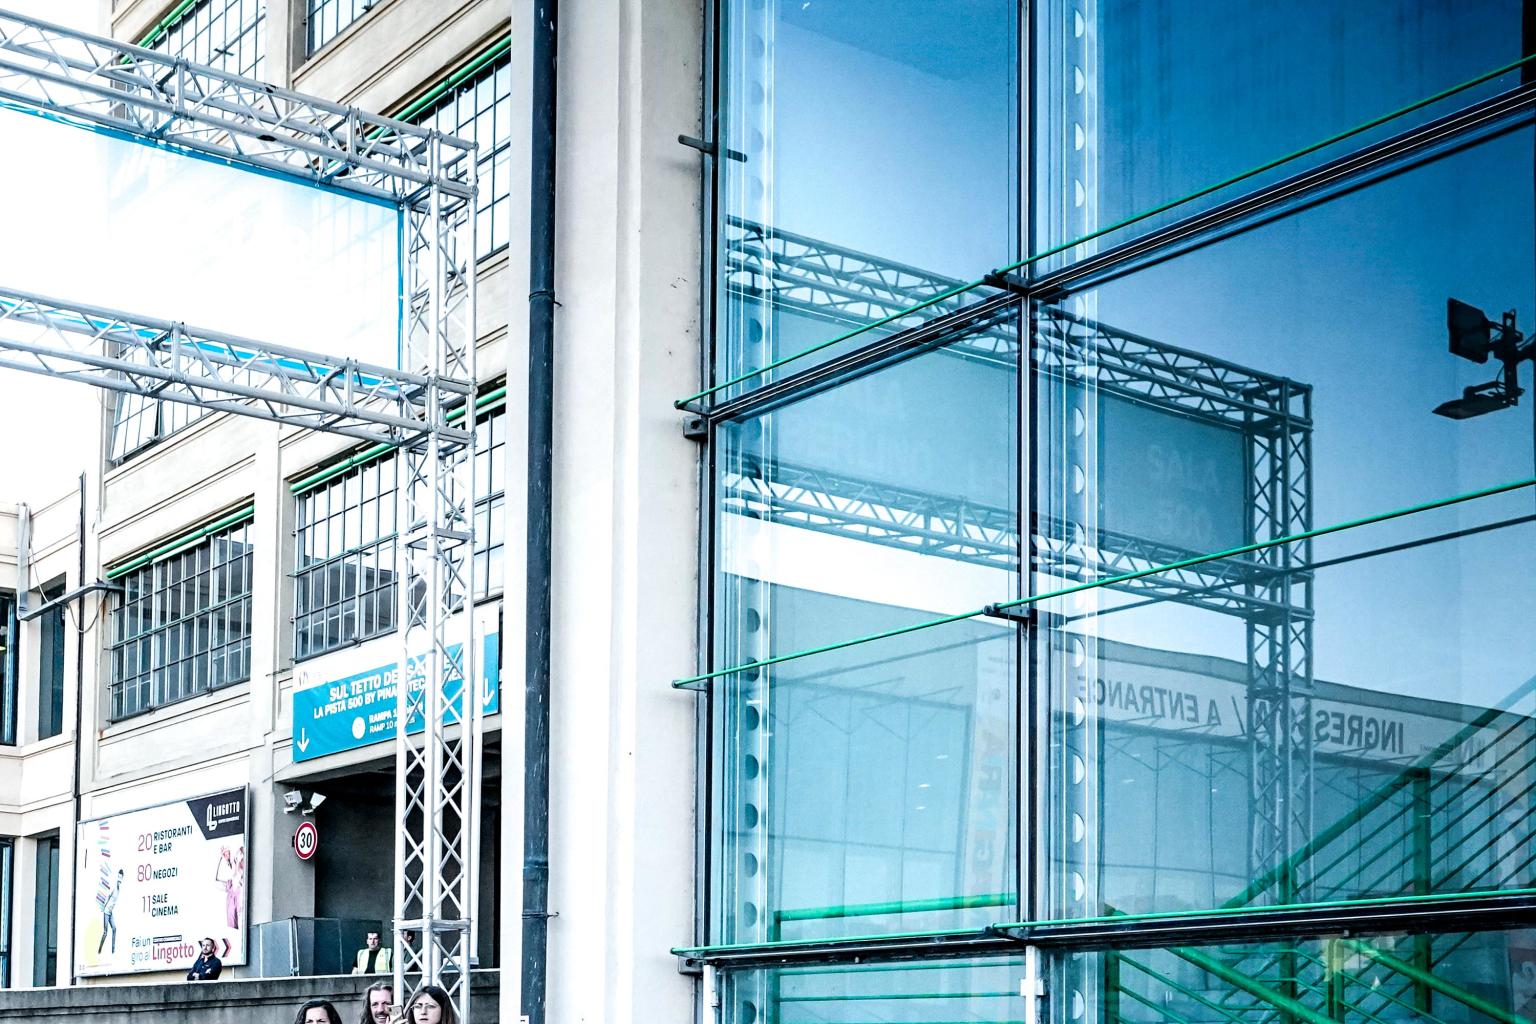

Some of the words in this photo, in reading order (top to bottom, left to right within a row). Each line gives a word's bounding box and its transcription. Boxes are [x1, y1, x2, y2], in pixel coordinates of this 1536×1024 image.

[329, 686, 349, 702] SUL
[350, 674, 381, 695] TETTO
[383, 669, 398, 687] DE
[314, 707, 324, 719] LA
[325, 700, 347, 717] PISTA
[347, 696, 364, 711] 500
[364, 692, 376, 706] BY
[213, 801, 240, 817] LINGOTTO
[138, 832, 153, 852] 20
[153, 825, 193, 841] RISTORANTI
[153, 844, 158, 854] E
[159, 842, 173, 852] BAR
[300, 832, 313, 848] 30
[137, 863, 152, 882] 80
[153, 867, 178, 880] NEGOZI
[142, 895, 151, 913] 11
[152, 893, 168, 905] SALE
[151, 905, 179, 918] CINEMA
[152, 943, 195, 964] Lingotto
